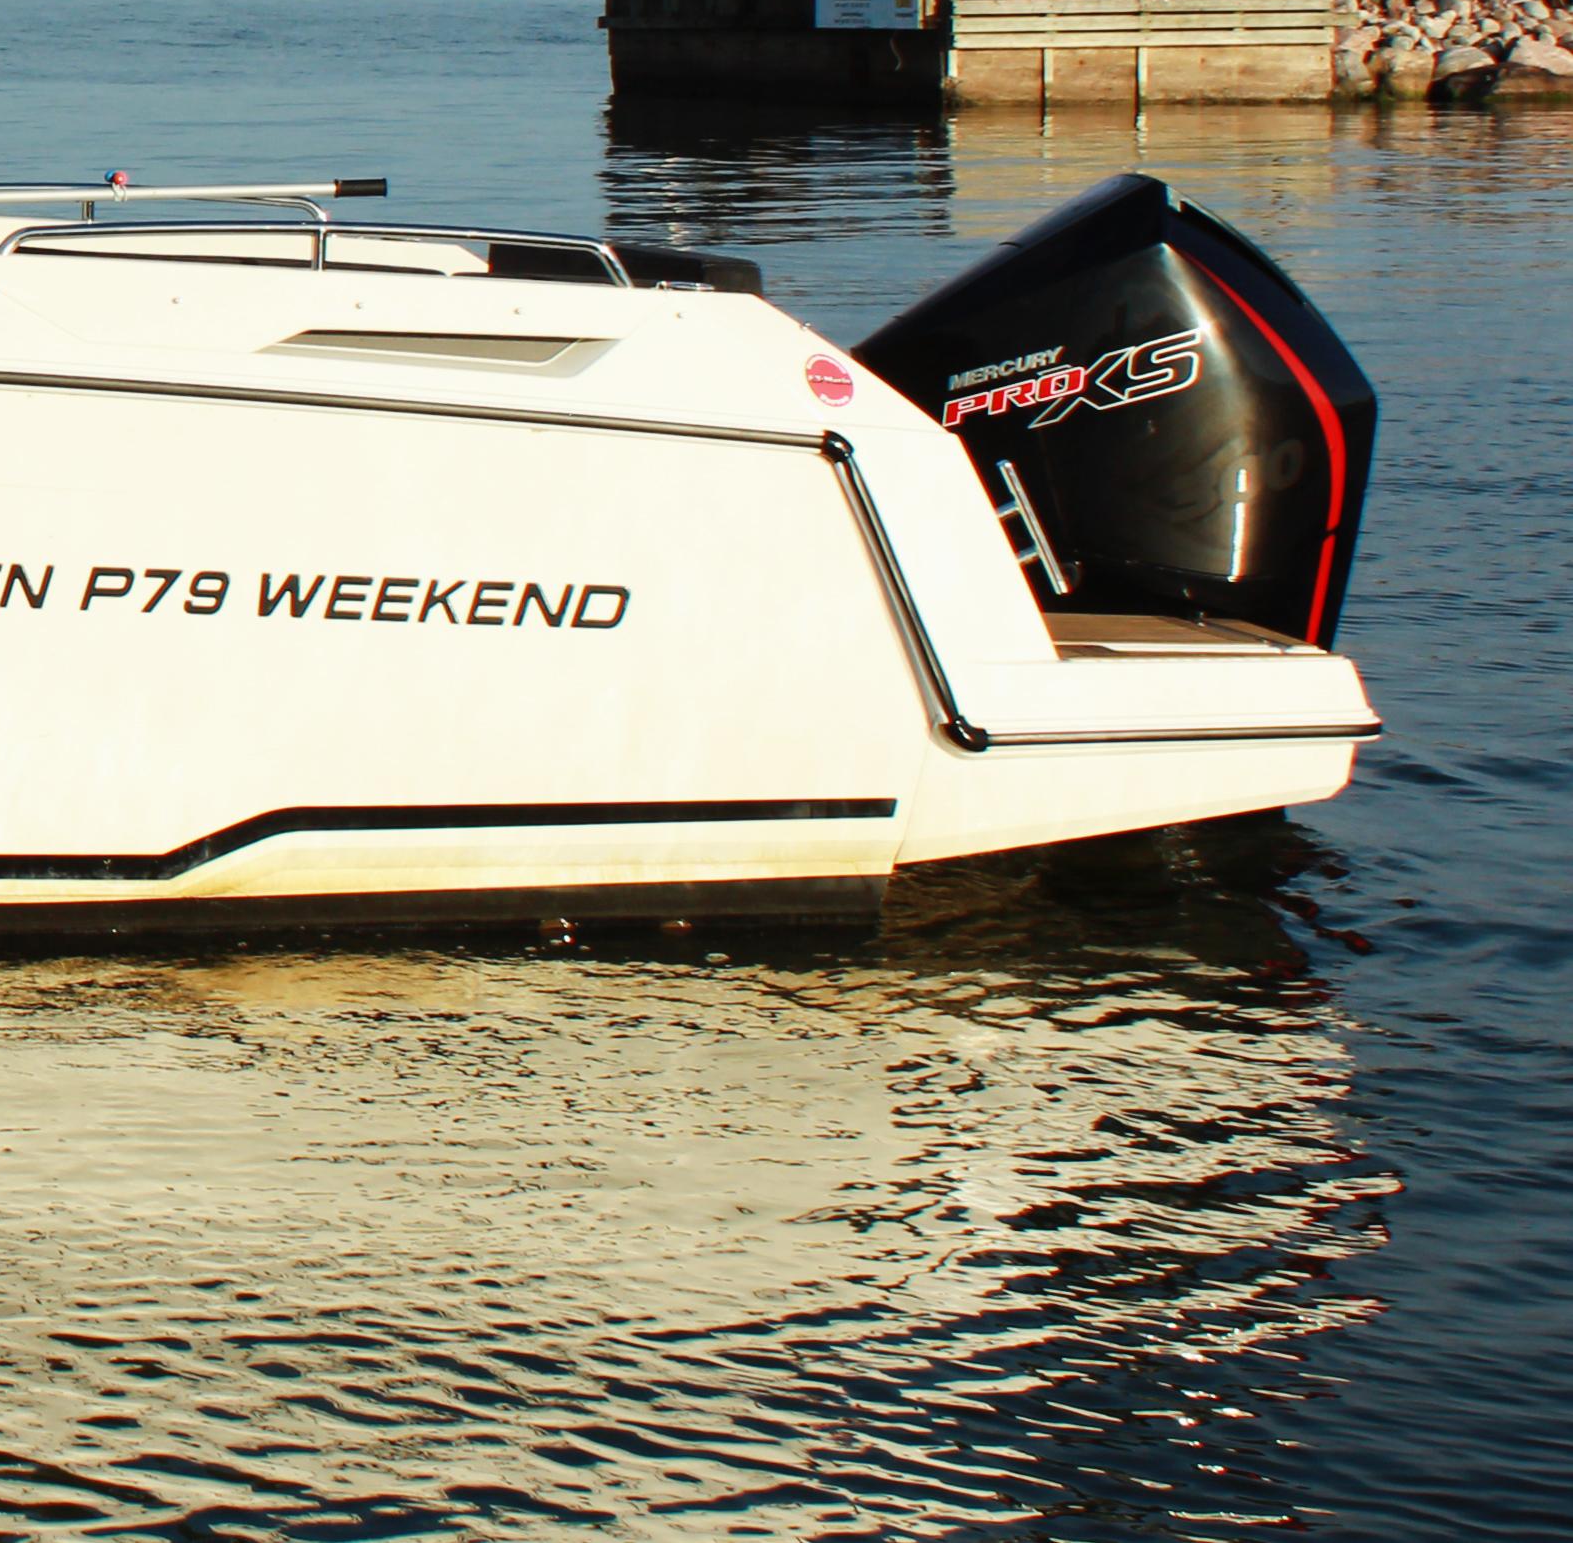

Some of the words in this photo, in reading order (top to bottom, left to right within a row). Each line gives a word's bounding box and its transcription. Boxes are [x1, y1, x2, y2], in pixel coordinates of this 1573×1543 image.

[942, 366, 1086, 428] PRO
[948, 345, 1066, 392] MERCURY
[81, 566, 231, 615] P79
[258, 573, 631, 629] WEEKEND
